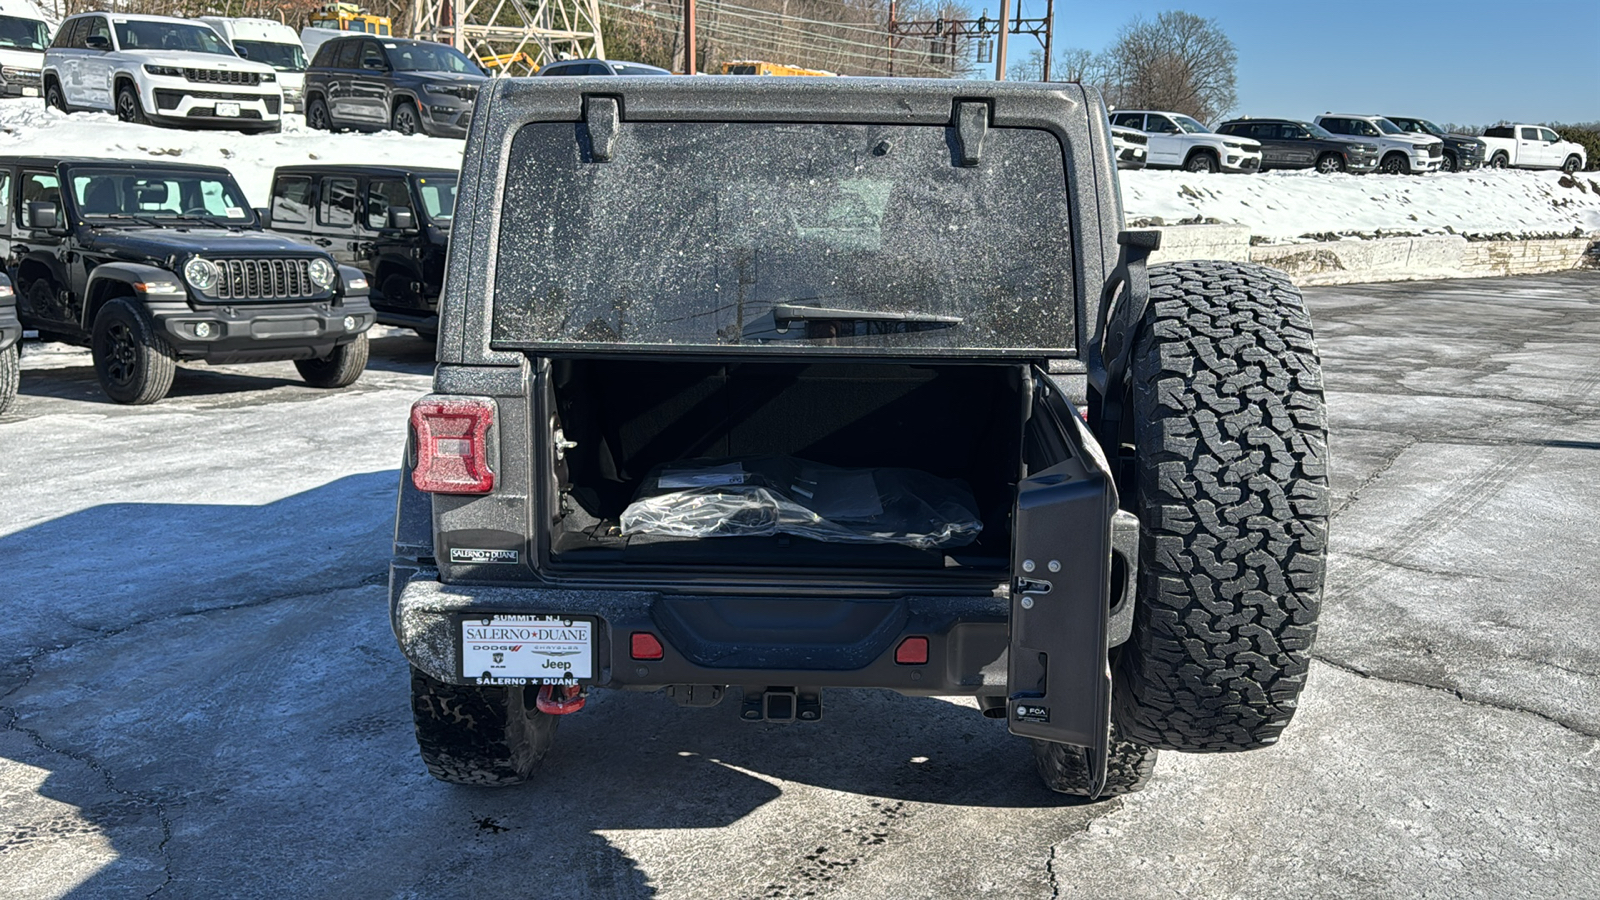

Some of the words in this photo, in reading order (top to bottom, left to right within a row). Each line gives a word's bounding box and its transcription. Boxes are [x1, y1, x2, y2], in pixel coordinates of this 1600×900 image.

[466, 628, 531, 640] SALERNO
[538, 629, 588, 641] DUANE
[541, 659, 572, 671] Jeep
[476, 677, 527, 685] SALERNO
[543, 678, 579, 686] DUANE
